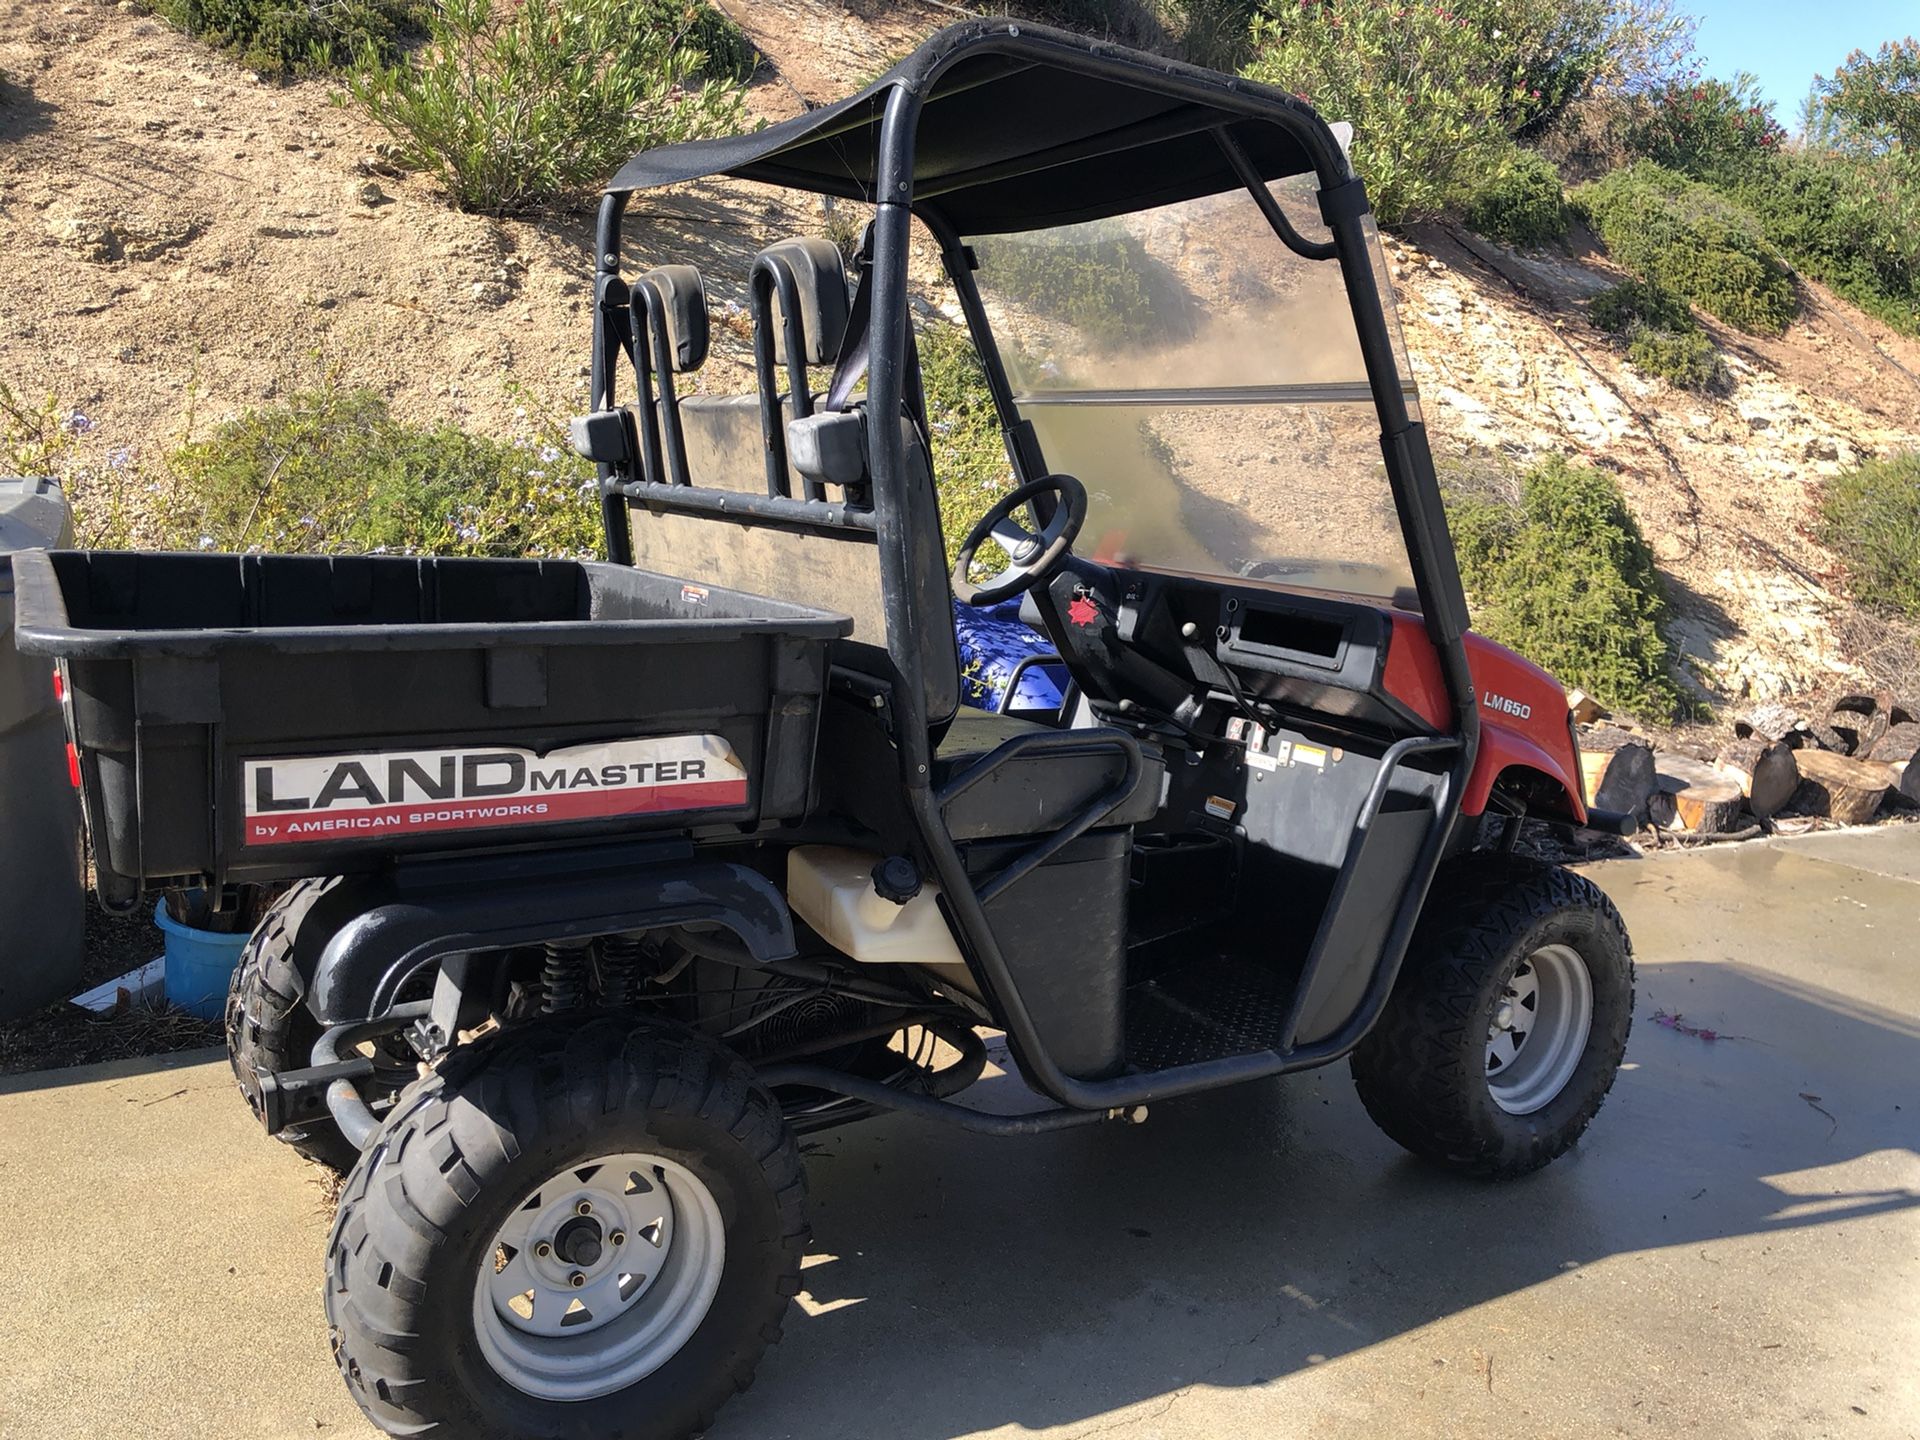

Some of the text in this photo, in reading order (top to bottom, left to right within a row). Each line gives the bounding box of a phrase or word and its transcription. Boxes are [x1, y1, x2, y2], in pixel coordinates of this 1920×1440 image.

[1483, 691, 1531, 719] LM650
[255, 803, 548, 837] by AMERICAN SPORTWORKS
